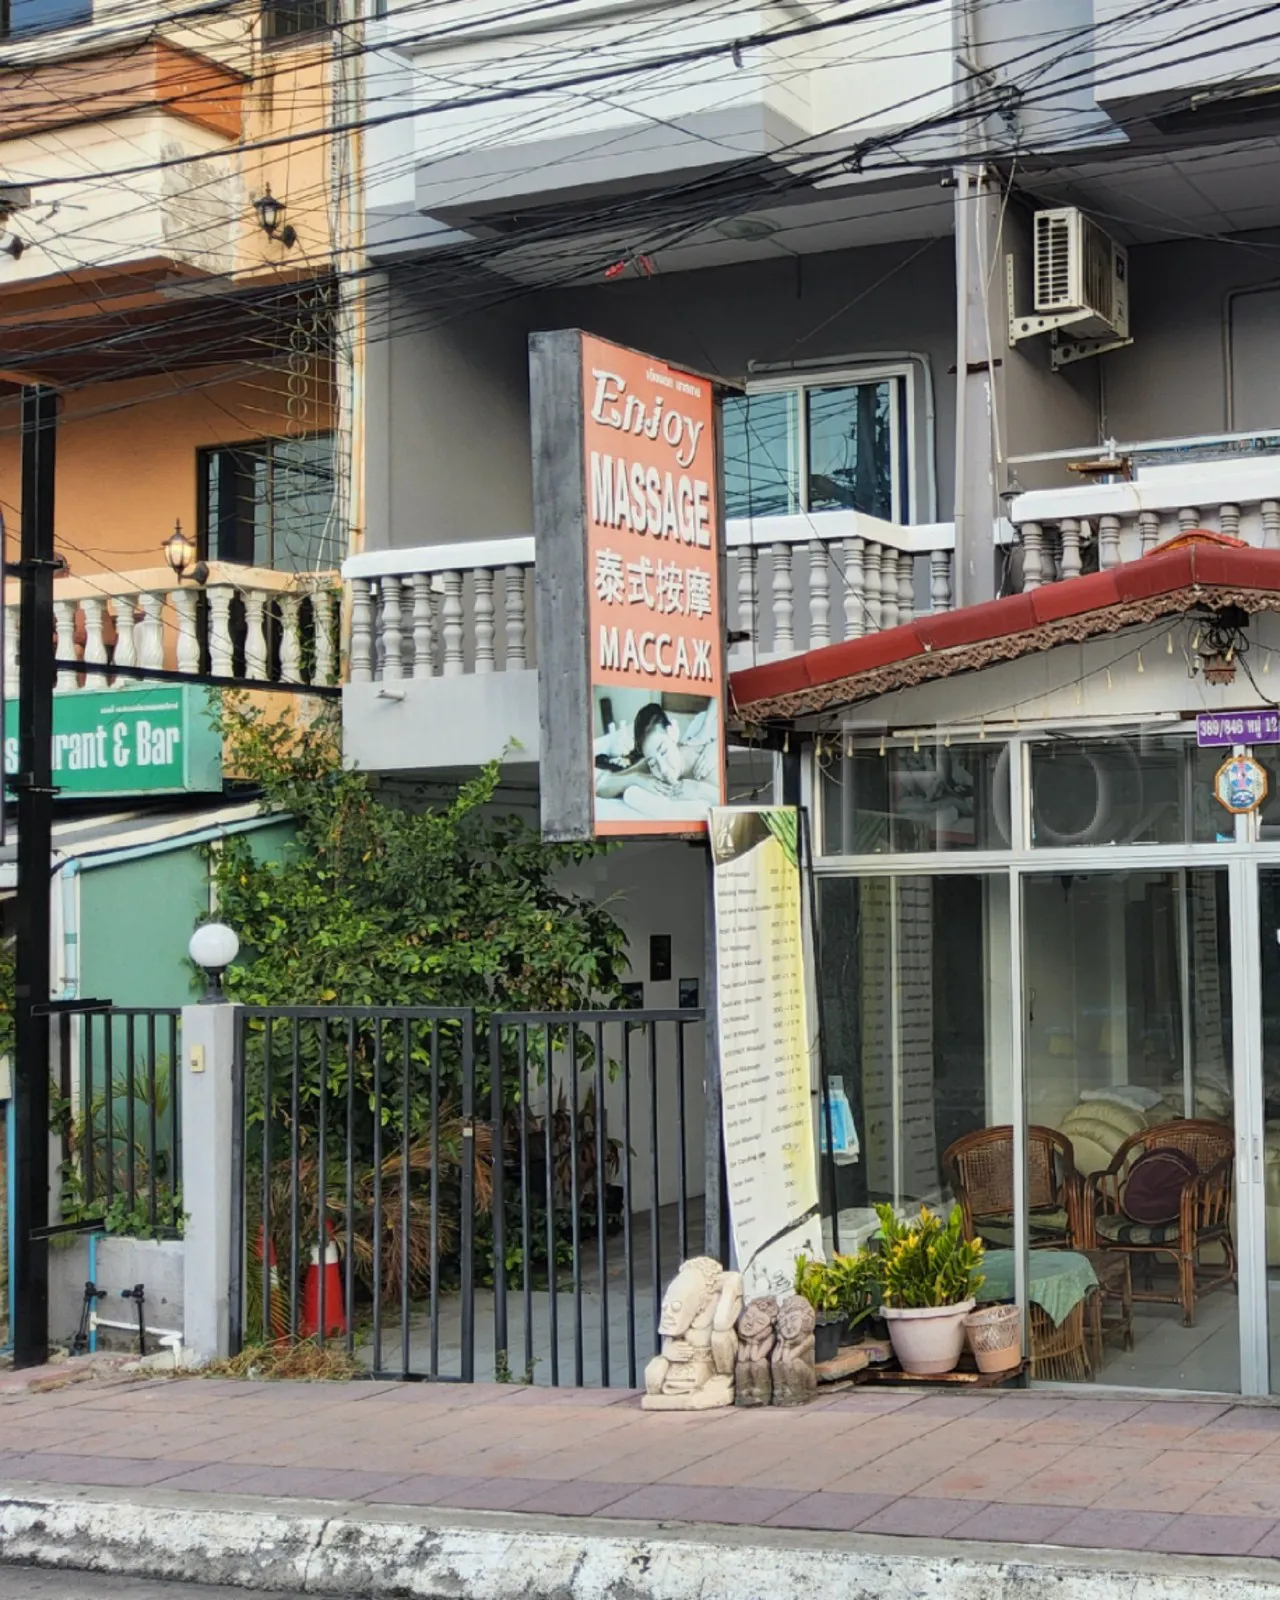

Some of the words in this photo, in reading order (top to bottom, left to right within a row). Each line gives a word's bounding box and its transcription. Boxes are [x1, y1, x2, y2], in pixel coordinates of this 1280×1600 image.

[590, 367, 704, 468] Enjoy
[590, 451, 711, 547] MASSAGE
[594, 548, 712, 618] 泰式按摩
[599, 625, 713, 680] МАССАЖ
[113, 721, 131, 767] &
[136, 720, 181, 766] Bar
[1265, 716, 1279, 733] 12
